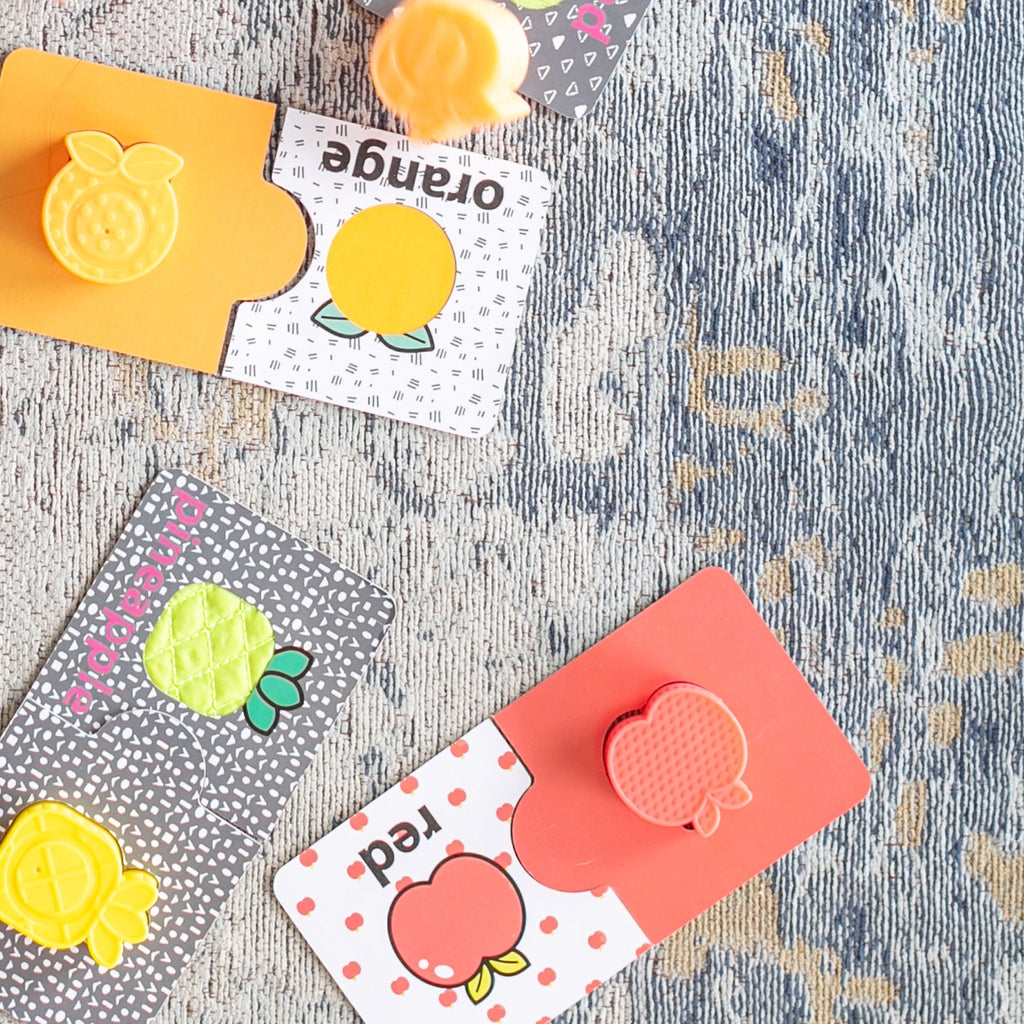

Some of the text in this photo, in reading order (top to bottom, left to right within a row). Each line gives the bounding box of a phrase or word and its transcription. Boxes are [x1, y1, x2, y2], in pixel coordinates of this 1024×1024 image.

[322, 140, 505, 212] orange
[63, 488, 206, 715] pineapple
[358, 805, 443, 889] red
